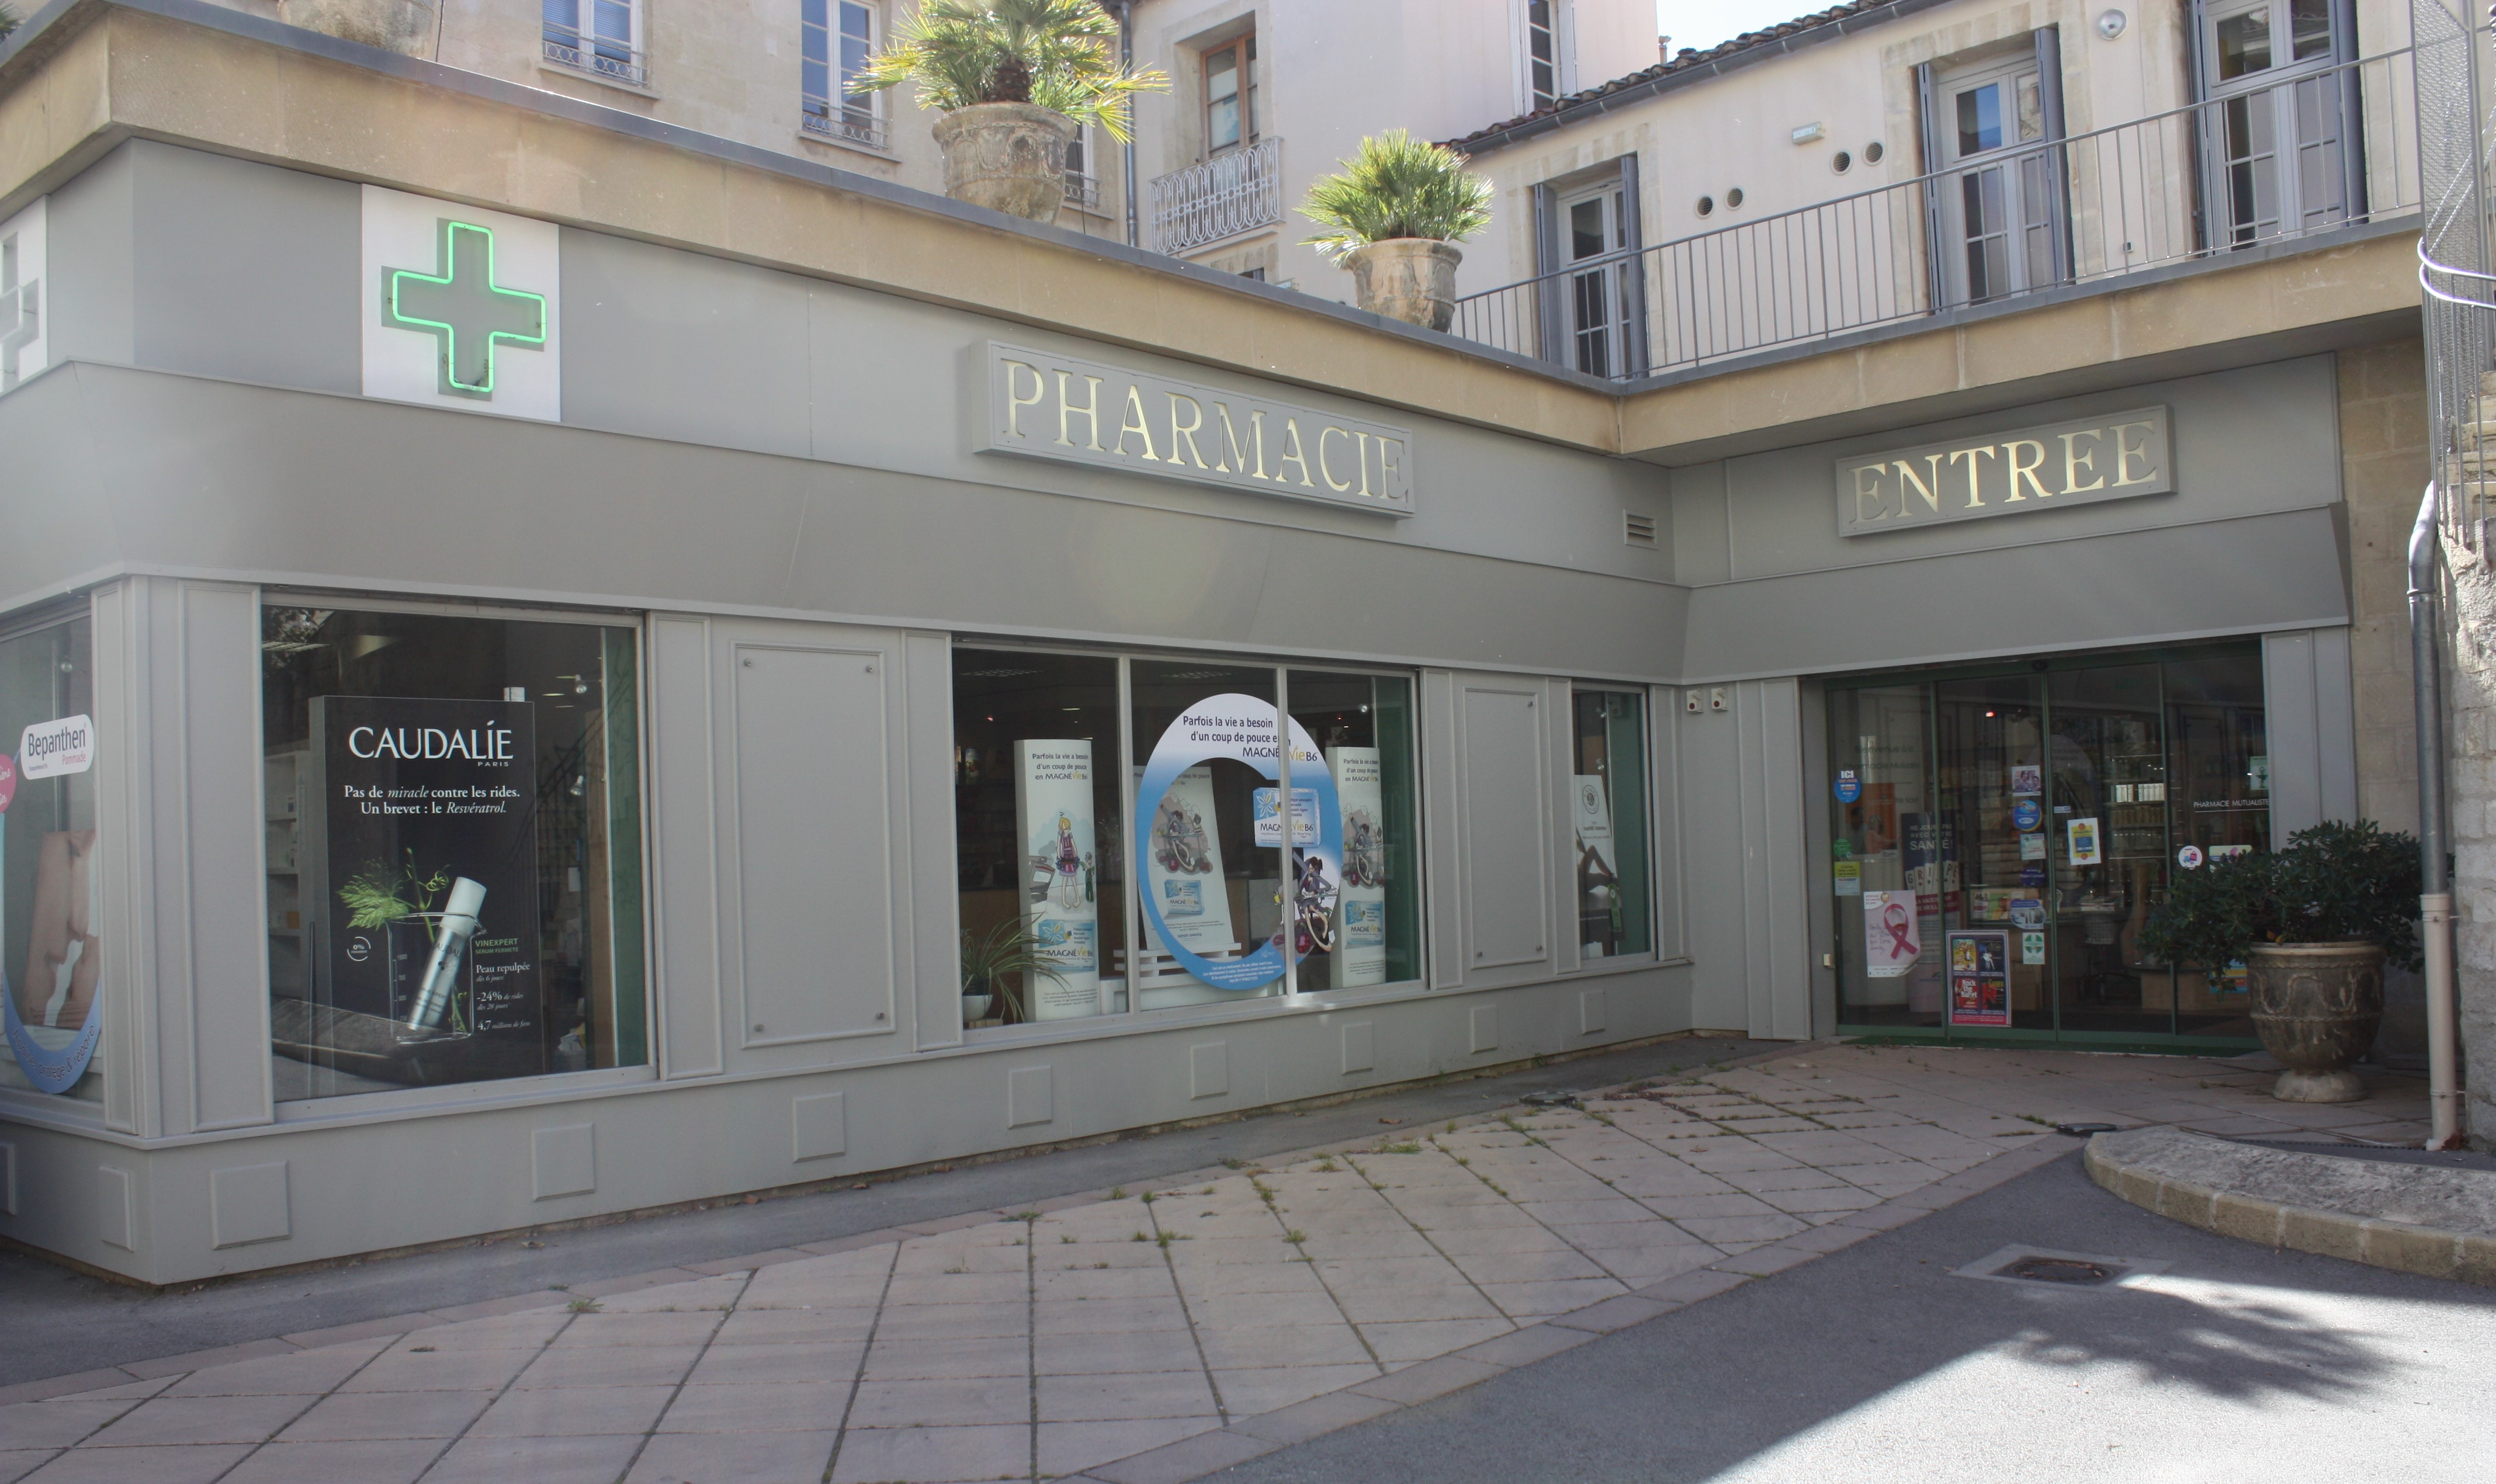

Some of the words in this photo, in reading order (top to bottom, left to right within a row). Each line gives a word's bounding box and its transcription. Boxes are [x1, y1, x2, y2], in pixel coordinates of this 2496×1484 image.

[1000, 358, 1410, 501] PHARMACIE
[1847, 419, 2158, 525] ENTREE
[1183, 716, 1213, 726] Parfois
[1215, 716, 1222, 726] la
[1225, 717, 1237, 727] vie
[1247, 717, 1273, 728] besoin
[28, 726, 85, 761] Bepanthen
[1191, 731, 1209, 741] d'un
[1212, 733, 1232, 744] coup
[1234, 732, 1244, 742] de
[1246, 734, 1270, 744] pouce
[62, 751, 86, 765] Pommade
[1840, 770, 1854, 779] ICI
[344, 785, 365, 798] Pas
[369, 785, 384, 798] de
[387, 785, 429, 798] miracle
[431, 789, 468, 798] contre
[472, 785, 487, 798] les
[490, 785, 521, 798] rides.
[360, 802, 380, 814] Un
[384, 802, 421, 814] brevet
[432, 802, 442, 814] le
[446, 800, 507, 814] Resvératrol.
[476, 965, 495, 973] Peau
[497, 962, 531, 975] repulpée
[476, 991, 502, 1002] -24%
[477, 1020, 491, 1031] 4,7
